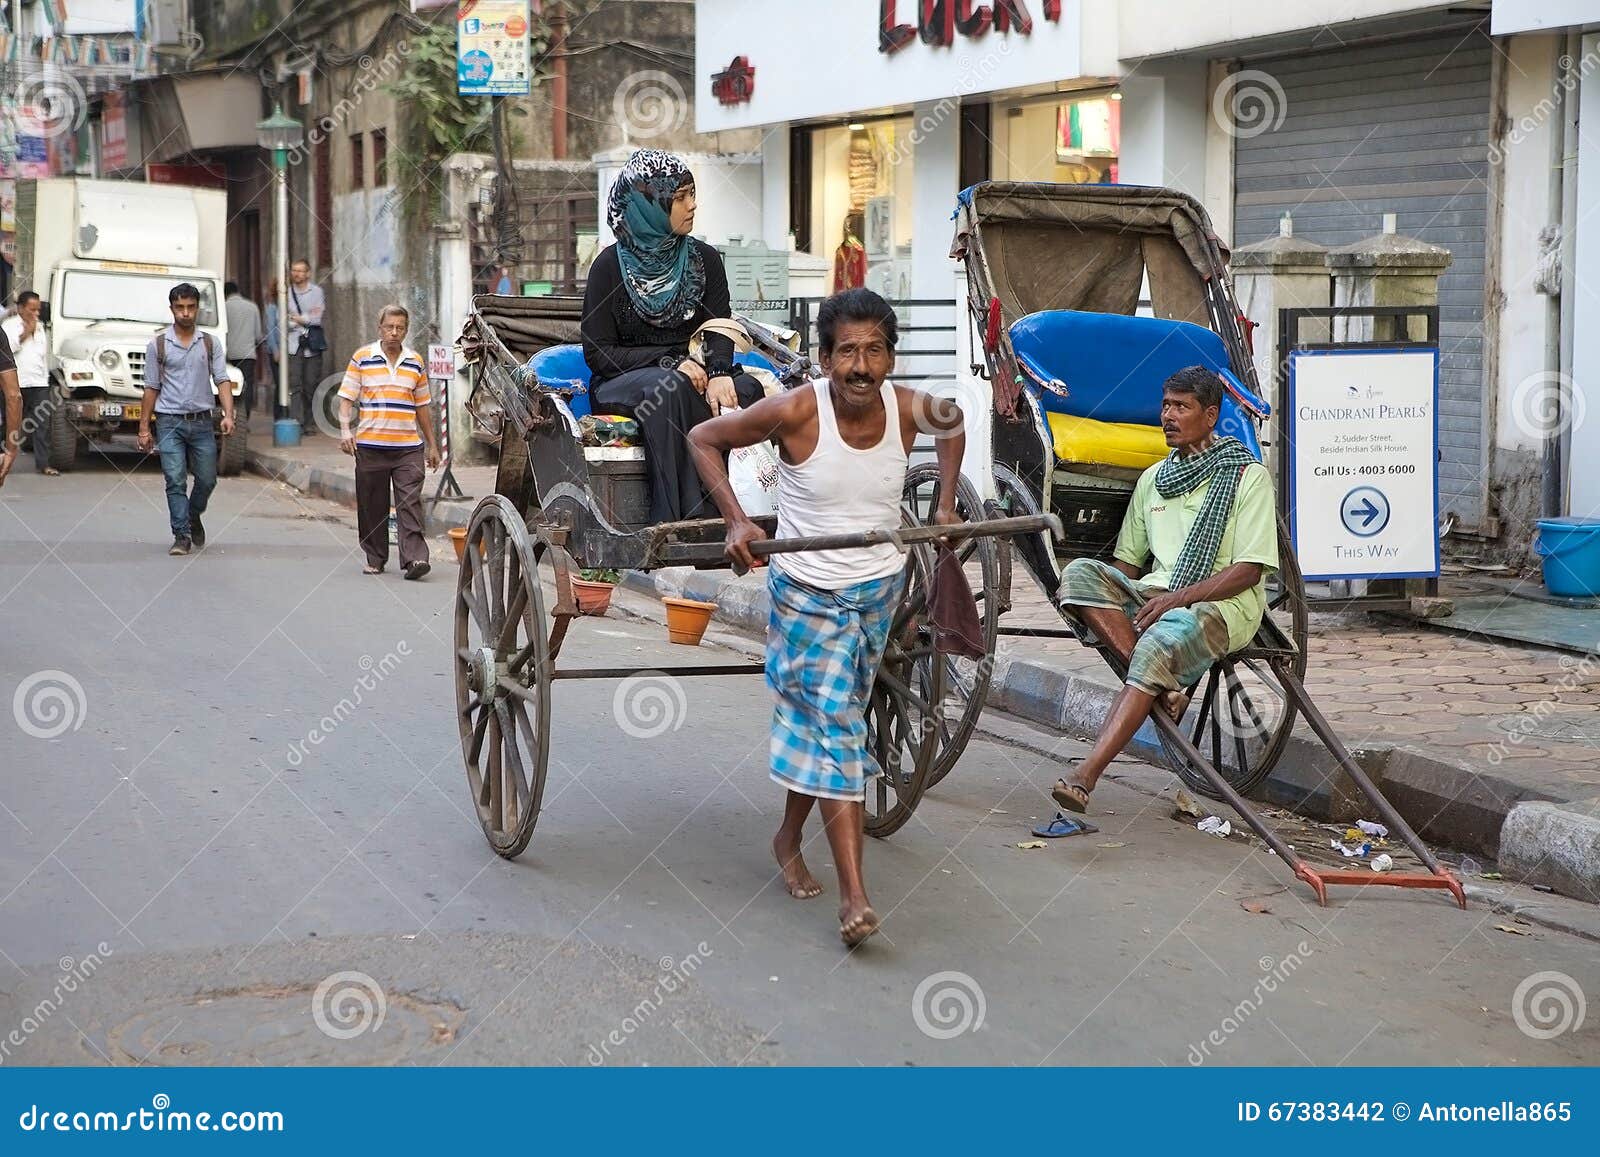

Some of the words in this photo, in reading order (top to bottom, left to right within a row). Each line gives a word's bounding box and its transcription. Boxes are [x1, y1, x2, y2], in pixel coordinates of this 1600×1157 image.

[879, 0, 1064, 52] LUCK
[434, 348, 447, 359] NO
[1299, 406, 1375, 421] CHANDRANI
[1379, 404, 1426, 419] PEARLS
[1342, 434, 1368, 443] Sudder
[1320, 446, 1344, 454] Beside
[1346, 445, 1368, 453] Indian
[1370, 444, 1383, 452] Silk
[1314, 466, 1334, 477] Call
[1337, 466, 1350, 476] Us
[1358, 465, 1385, 475] 4003
[1388, 464, 1416, 474] 6000
[1333, 545, 1363, 559] THIS
[1367, 544, 1399, 558] WAY
